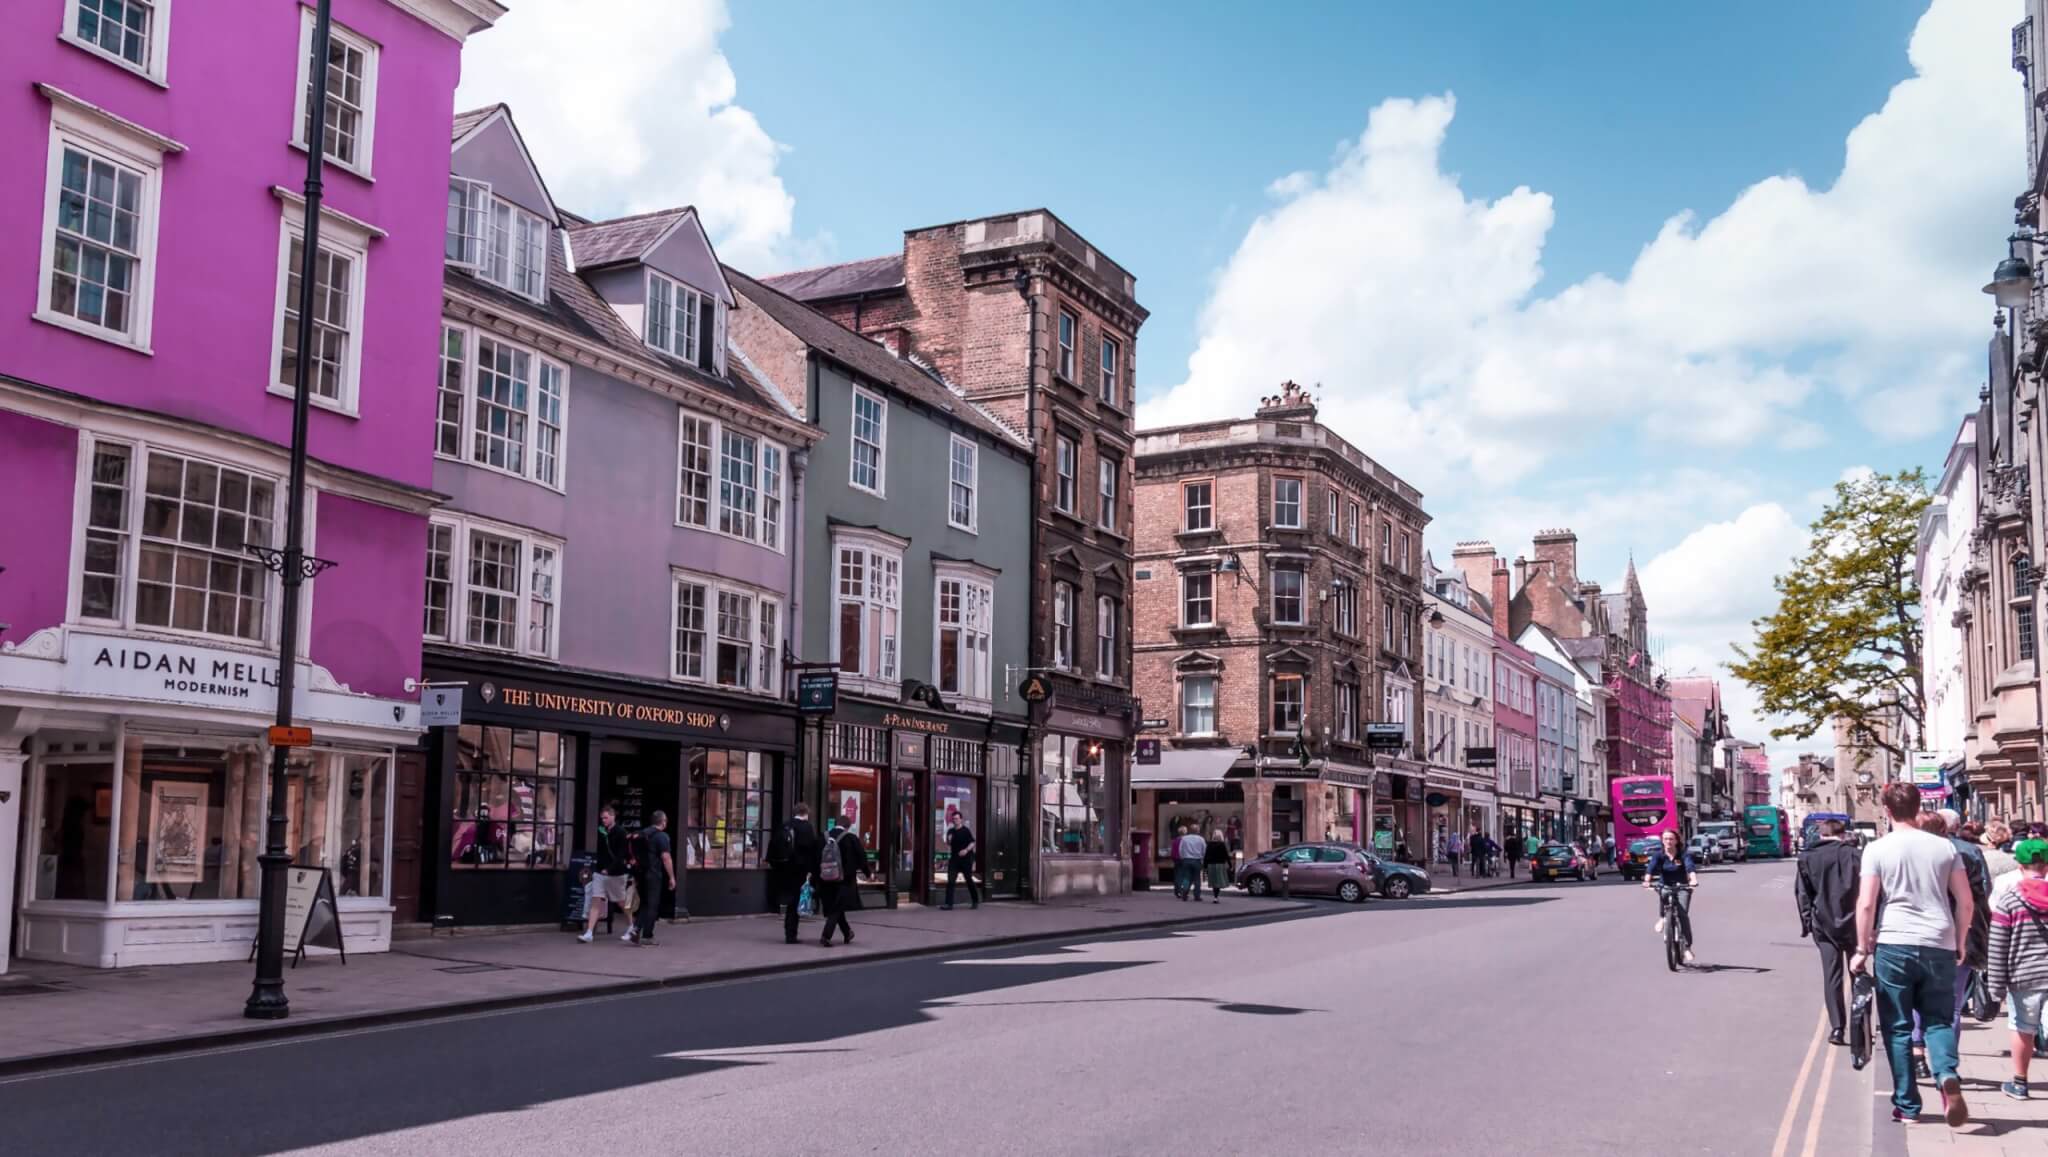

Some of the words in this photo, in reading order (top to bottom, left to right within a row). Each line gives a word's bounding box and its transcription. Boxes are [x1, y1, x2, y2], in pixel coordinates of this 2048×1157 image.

[94, 647, 196, 675] AIDAN
[212, 660, 281, 688] MELLE
[164, 679, 249, 698] MODERNISM
[502, 687, 531, 706] THE
[535, 692, 615, 717] UNIVERSITY
[617, 702, 634, 718] OF
[635, 705, 684, 724] OXFORD
[687, 712, 716, 728] SHOP
